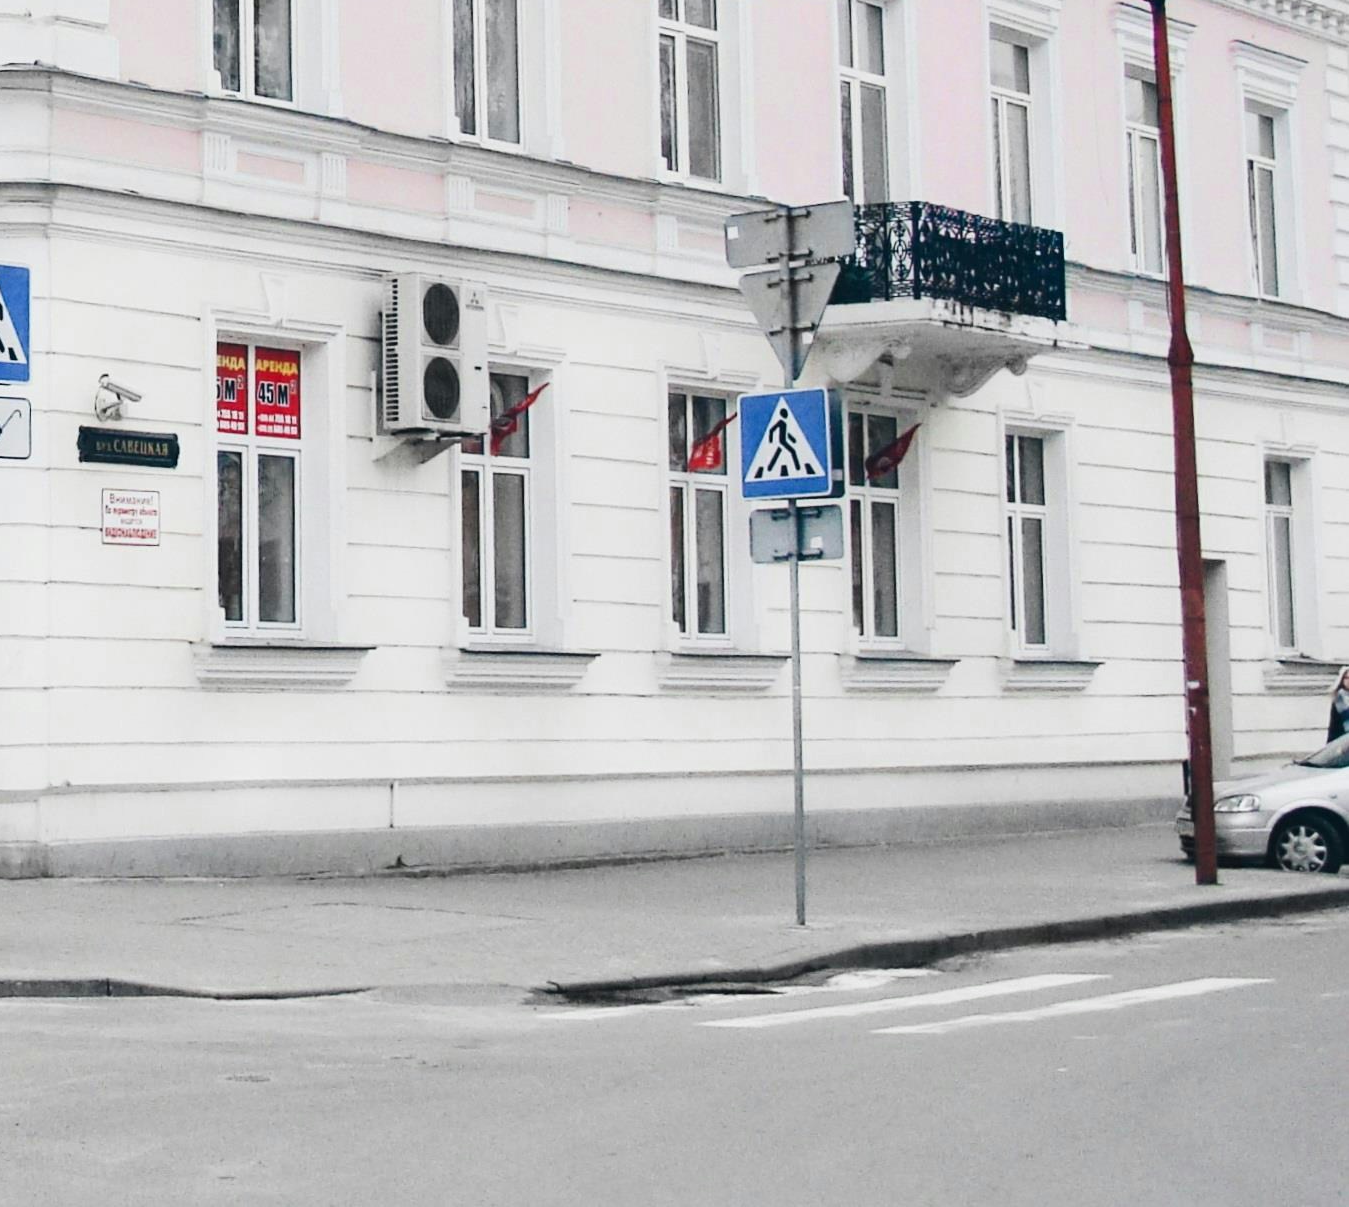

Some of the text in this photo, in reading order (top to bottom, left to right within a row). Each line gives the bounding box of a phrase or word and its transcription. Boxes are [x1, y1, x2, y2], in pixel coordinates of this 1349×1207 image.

[255, 359, 298, 377] АРЕНДА
[257, 380, 275, 407] 45
[113, 439, 169, 456] САВЕЦКАЯ
